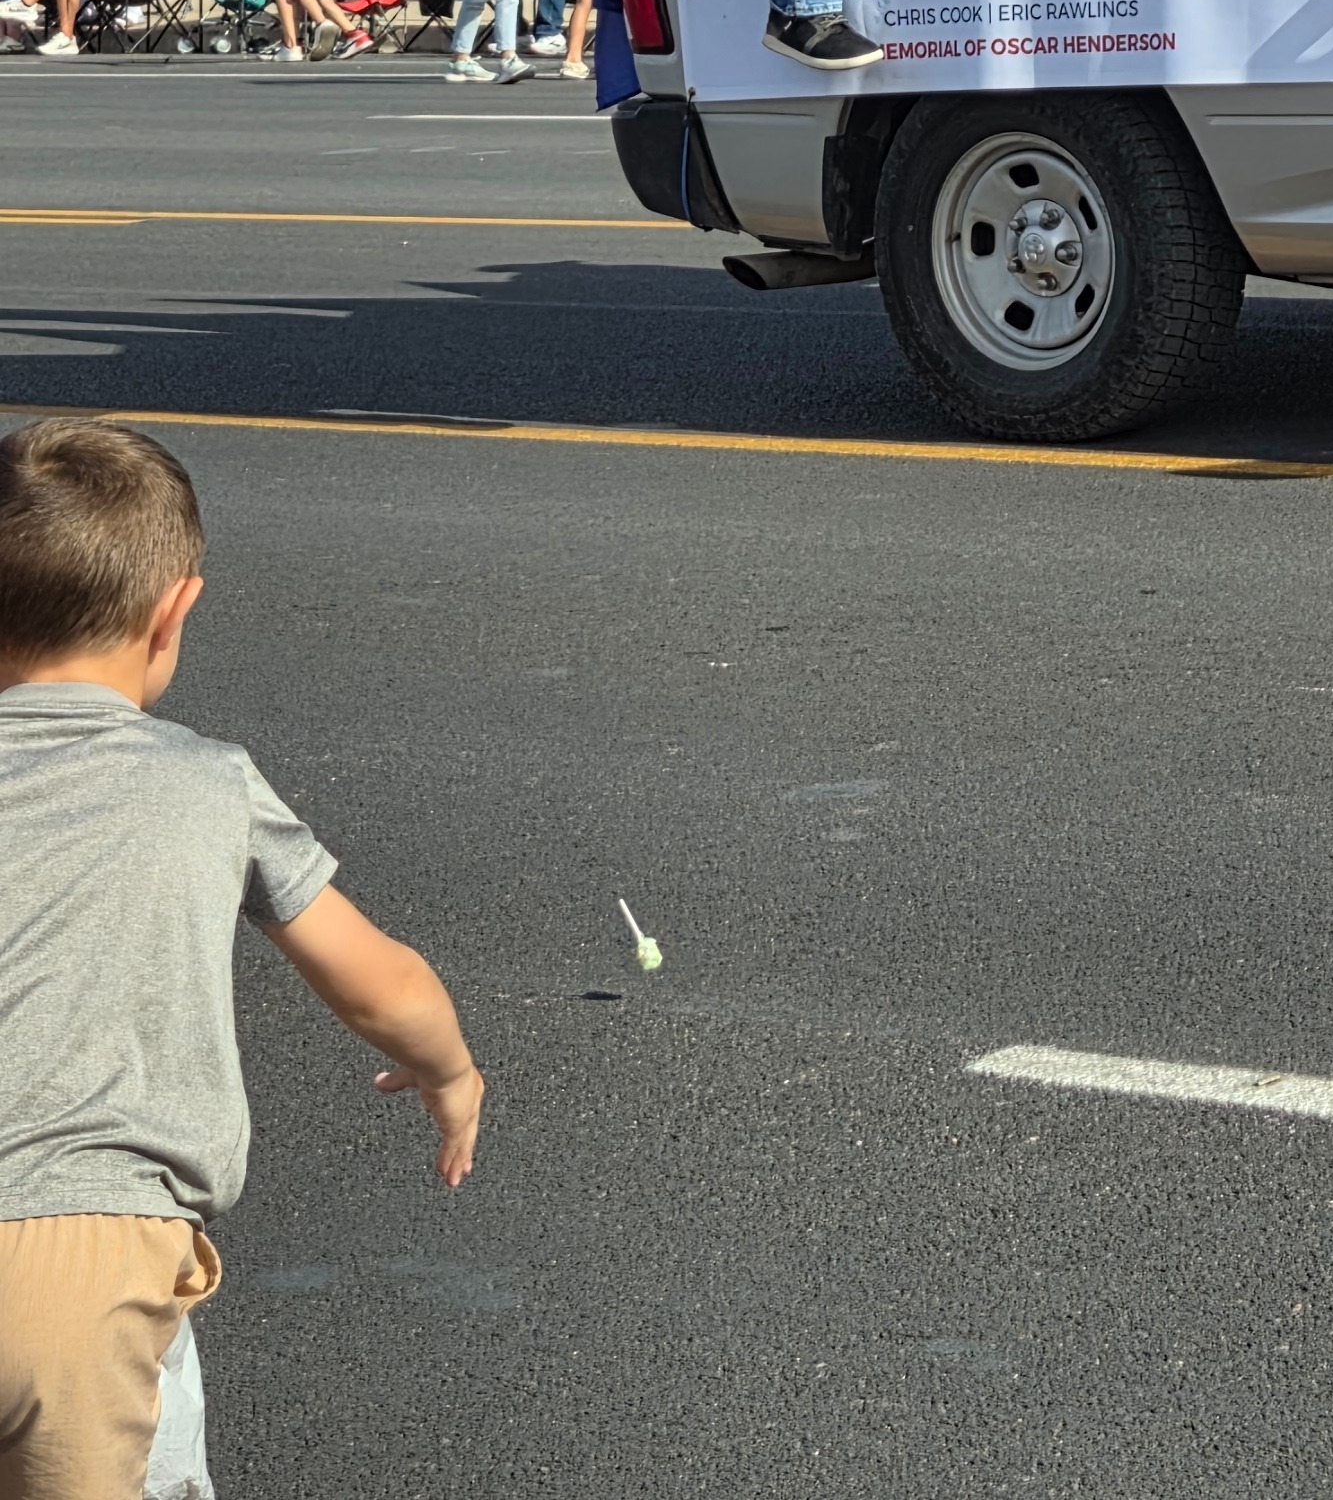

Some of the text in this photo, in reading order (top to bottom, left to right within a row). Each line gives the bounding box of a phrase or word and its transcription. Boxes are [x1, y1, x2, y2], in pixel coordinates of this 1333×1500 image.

[884, 0, 1139, 27] CHRIS COOK ERIC RAWLINGS
[881, 32, 1176, 60] EMORIAL OF OSCAR HENDERSON
